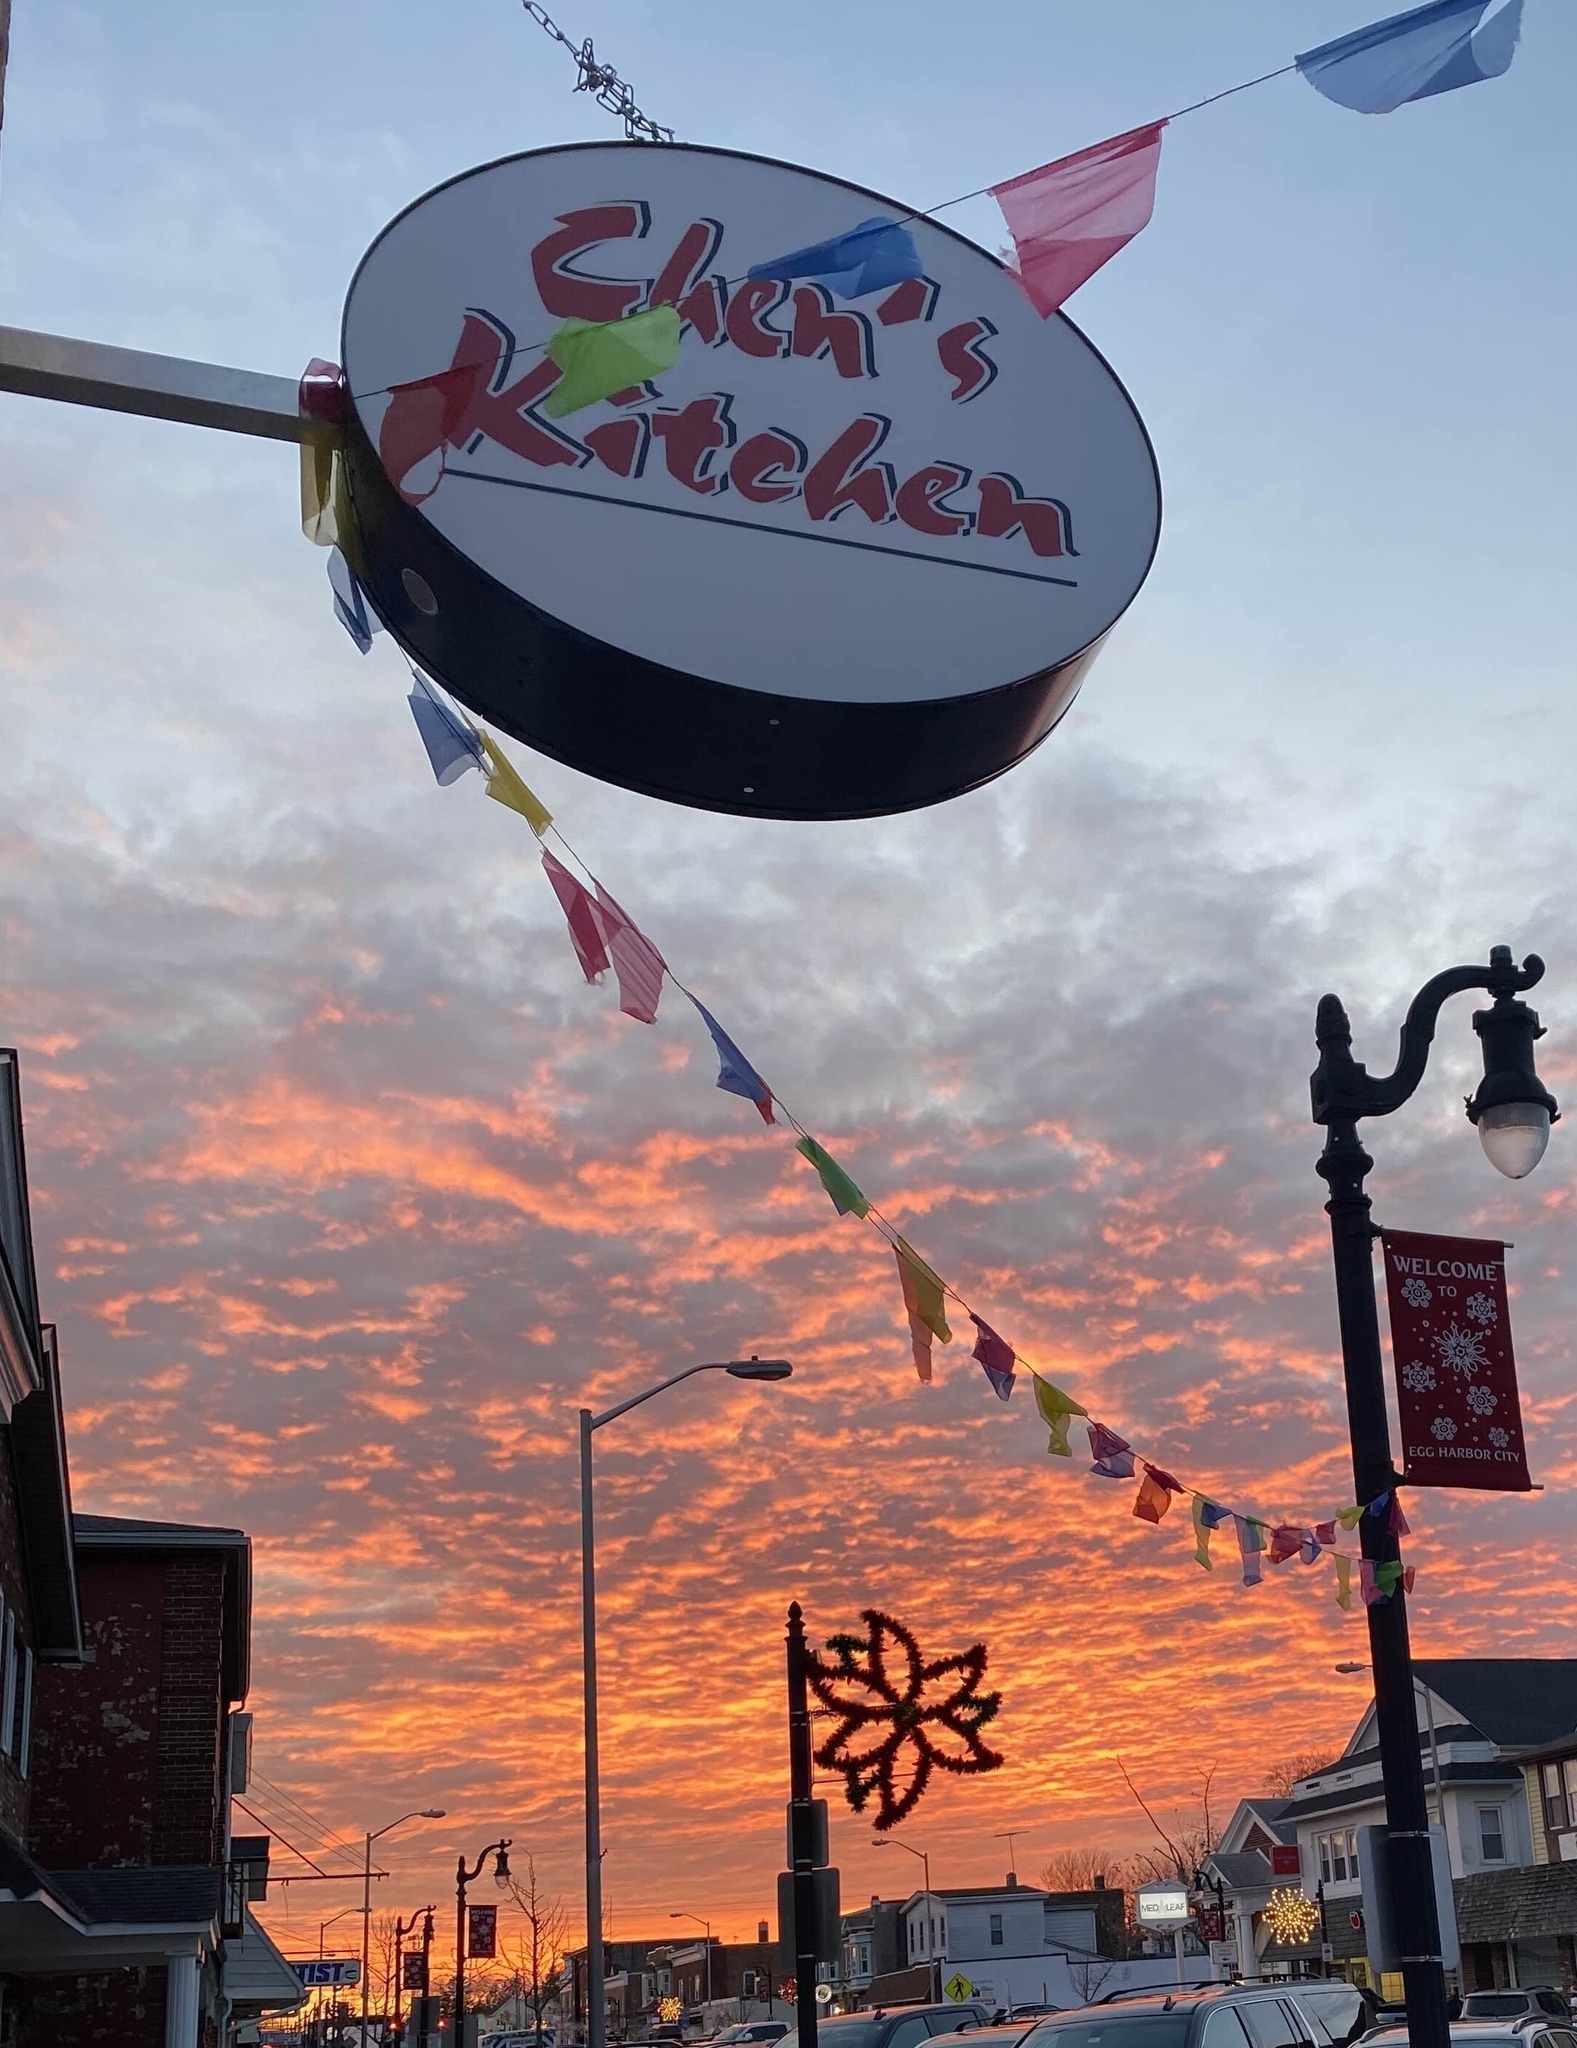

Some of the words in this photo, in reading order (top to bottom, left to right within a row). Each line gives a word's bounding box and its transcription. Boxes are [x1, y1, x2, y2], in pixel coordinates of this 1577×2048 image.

[531, 200, 1000, 404] Chen's
[443, 306, 1081, 558] Kitchen
[1392, 1254, 1498, 1281] WELCOME
[1437, 1285, 1458, 1297] TO
[1408, 1446, 1435, 1457] EGG
[1438, 1447, 1491, 1460] HARBOR
[1494, 1450, 1520, 1462] CITY
[1141, 1903, 1160, 1912] MED
[1166, 1902, 1186, 1911] LEAF
[292, 1962, 345, 1983] TIST
